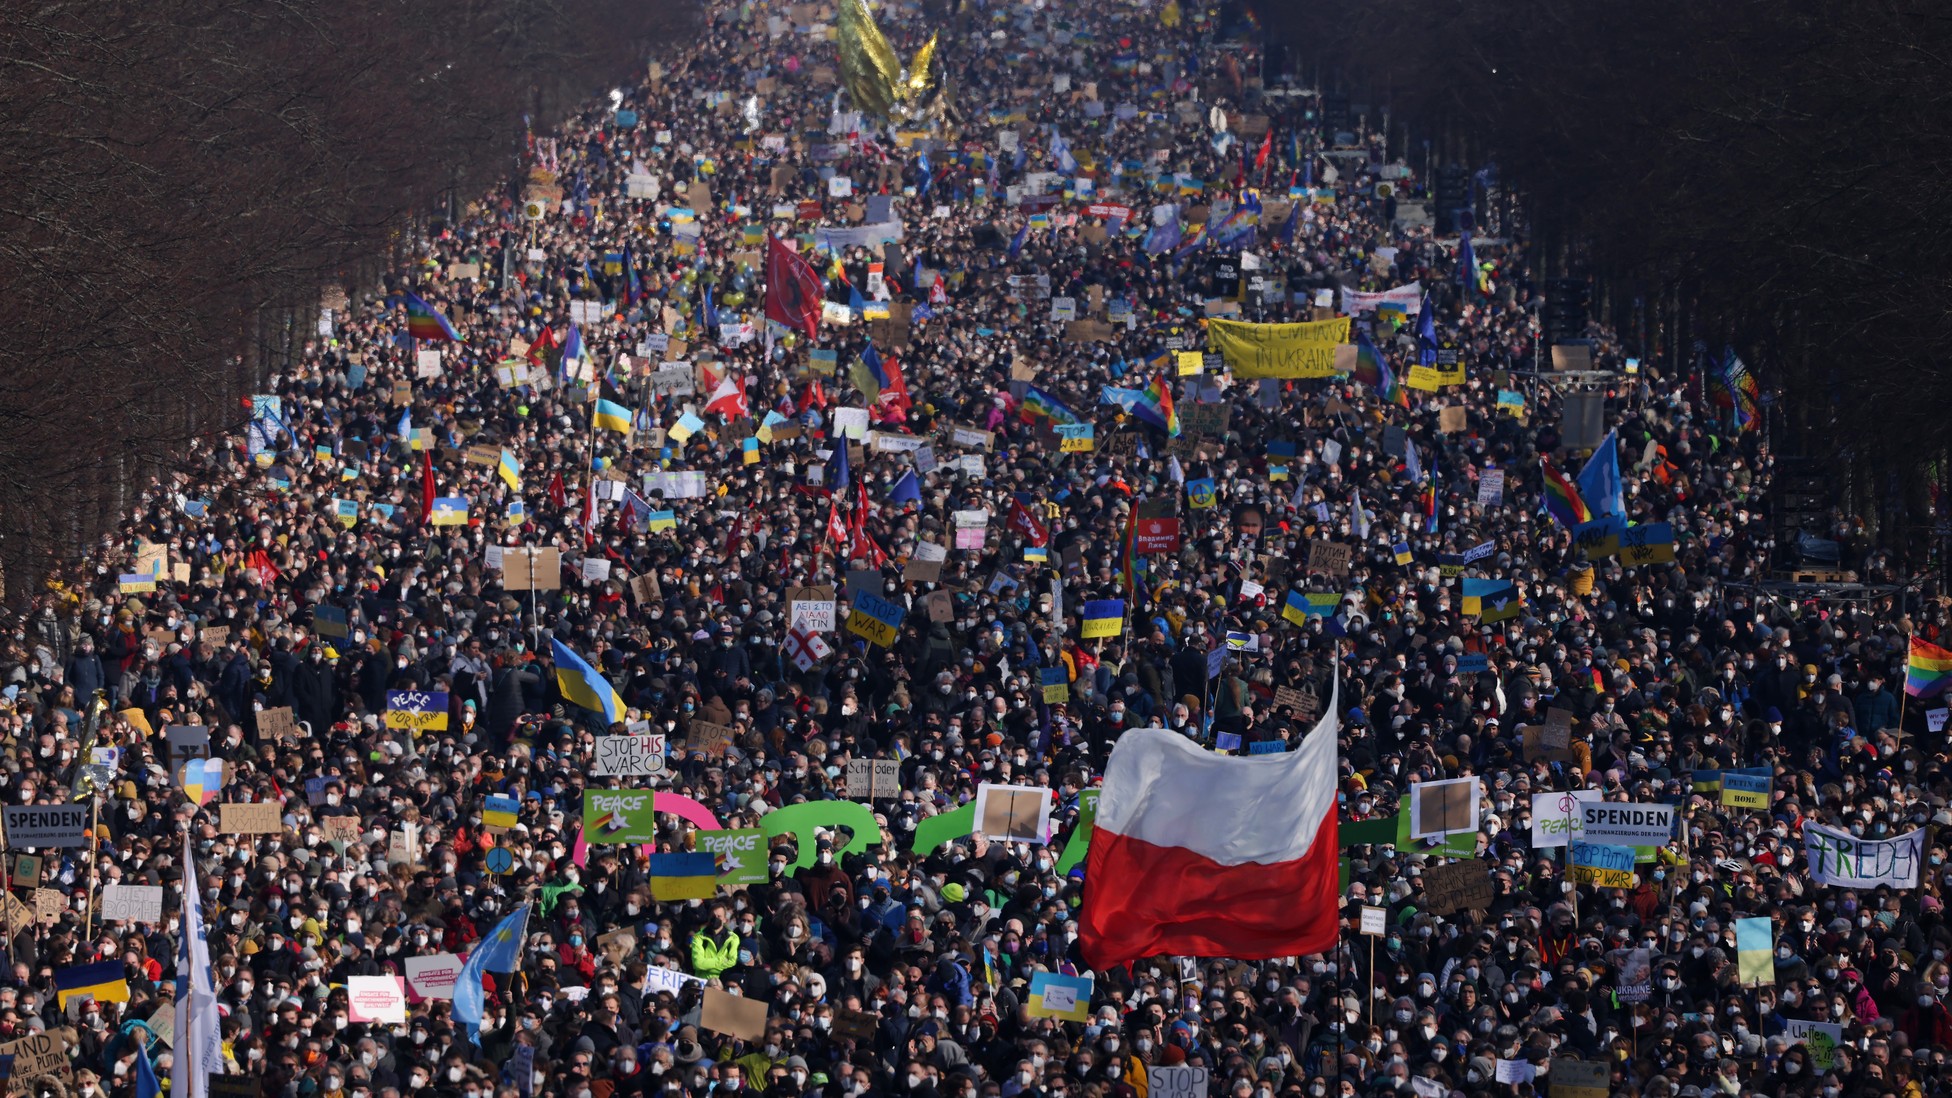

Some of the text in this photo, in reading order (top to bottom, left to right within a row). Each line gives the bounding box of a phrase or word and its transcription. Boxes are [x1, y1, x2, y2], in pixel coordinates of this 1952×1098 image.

[1279, 324, 1347, 341] CIVILIANS
[1255, 349, 1273, 368] IN
[1059, 427, 1086, 436] STOP
[1061, 440, 1083, 449] WAR
[1315, 544, 1346, 557] ПУТИН
[1312, 558, 1346, 569] ЛЖЕТ
[861, 595, 897, 618] STOP
[853, 617, 887, 641] WAR
[392, 692, 431, 707] PEACE
[391, 710, 412, 727] FOR
[693, 722, 728, 740] STOP
[600, 736, 664, 758] STOP HIS
[1251, 741, 1282, 753] NO WAR
[600, 755, 641, 774] WAR
[1728, 780, 1766, 789] PUTIN GO
[591, 795, 648, 812] PEACE
[1734, 794, 1757, 804] HOME
[10, 811, 81, 829] SPENDEN
[229, 807, 275, 819] ПУТИН
[1585, 808, 1668, 827] SPENDEN
[329, 818, 354, 828] STOP
[330, 830, 356, 841] WAR
[703, 834, 761, 852] PEACE
[1573, 844, 1636, 869] STOP PUTIN
[1807, 828, 1919, 880] FRIEDEN
[1603, 870, 1631, 888] WAR
[116, 886, 149, 901] НЕТ
[1616, 984, 1651, 995] UKRAINE
[36, 1051, 64, 1071] PUTIN
[1151, 1067, 1206, 1092] STOP
